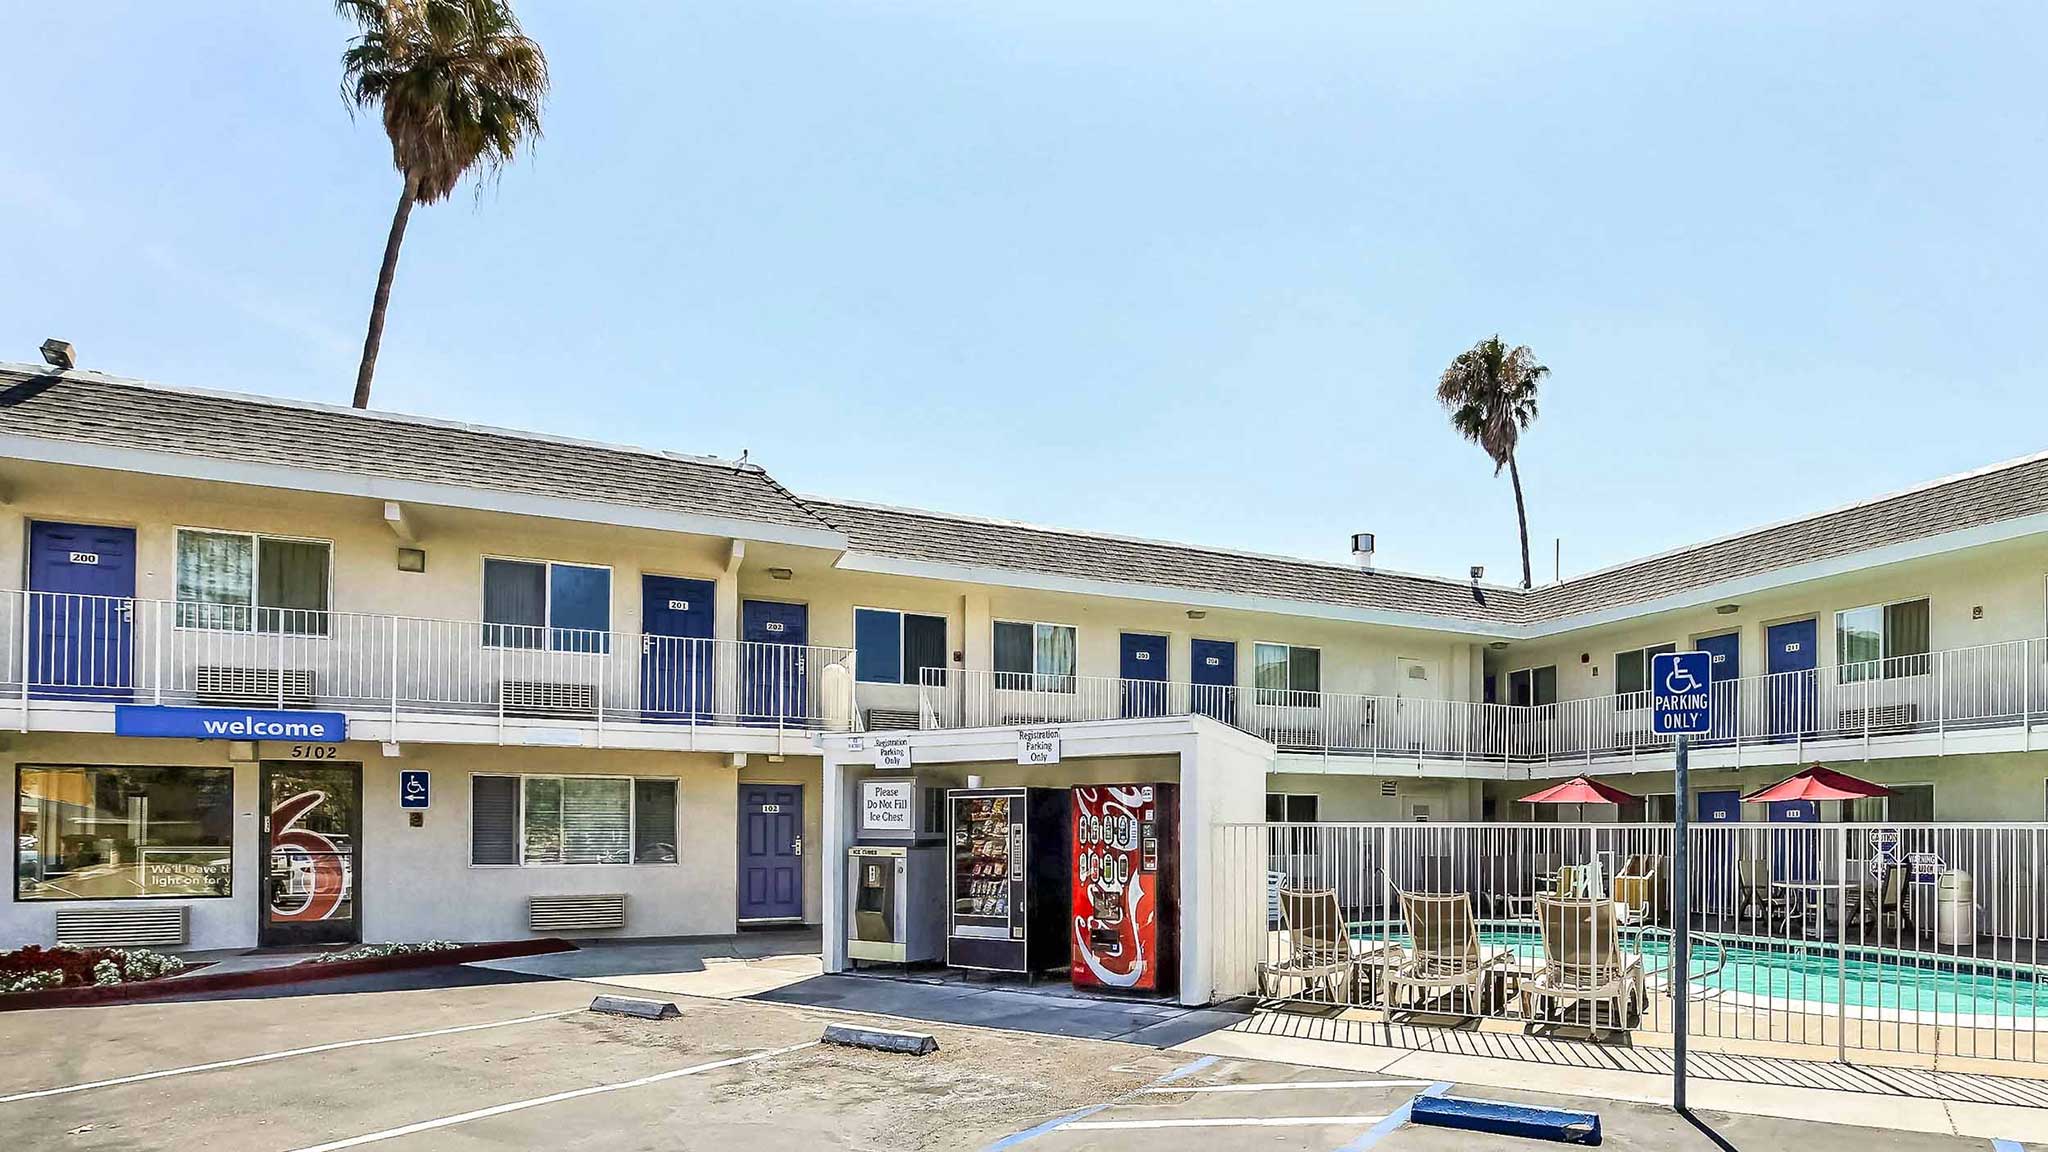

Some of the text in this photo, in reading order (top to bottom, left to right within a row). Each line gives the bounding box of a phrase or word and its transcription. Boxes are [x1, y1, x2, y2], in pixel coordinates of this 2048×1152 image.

[72, 553, 96, 563] 200
[670, 601, 687, 610] 201
[767, 623, 783, 631] 202
[1655, 693, 1708, 711] PARKING
[1664, 712, 1698, 729] ONLY
[203, 715, 325, 737] welcome
[1019, 730, 1059, 741] Registration
[875, 738, 908, 747] Registration
[1026, 742, 1053, 752] Parking
[291, 745, 336, 759] 5102
[880, 748, 905, 757] Parking
[1030, 752, 1048, 762] Only
[884, 756, 901, 765] Only
[875, 786, 899, 797] Please
[867, 799, 907, 809] Do Not Fill
[870, 811, 904, 822] Ice Chest
[185, 864, 217, 874] leave
[204, 875, 221, 885] for
